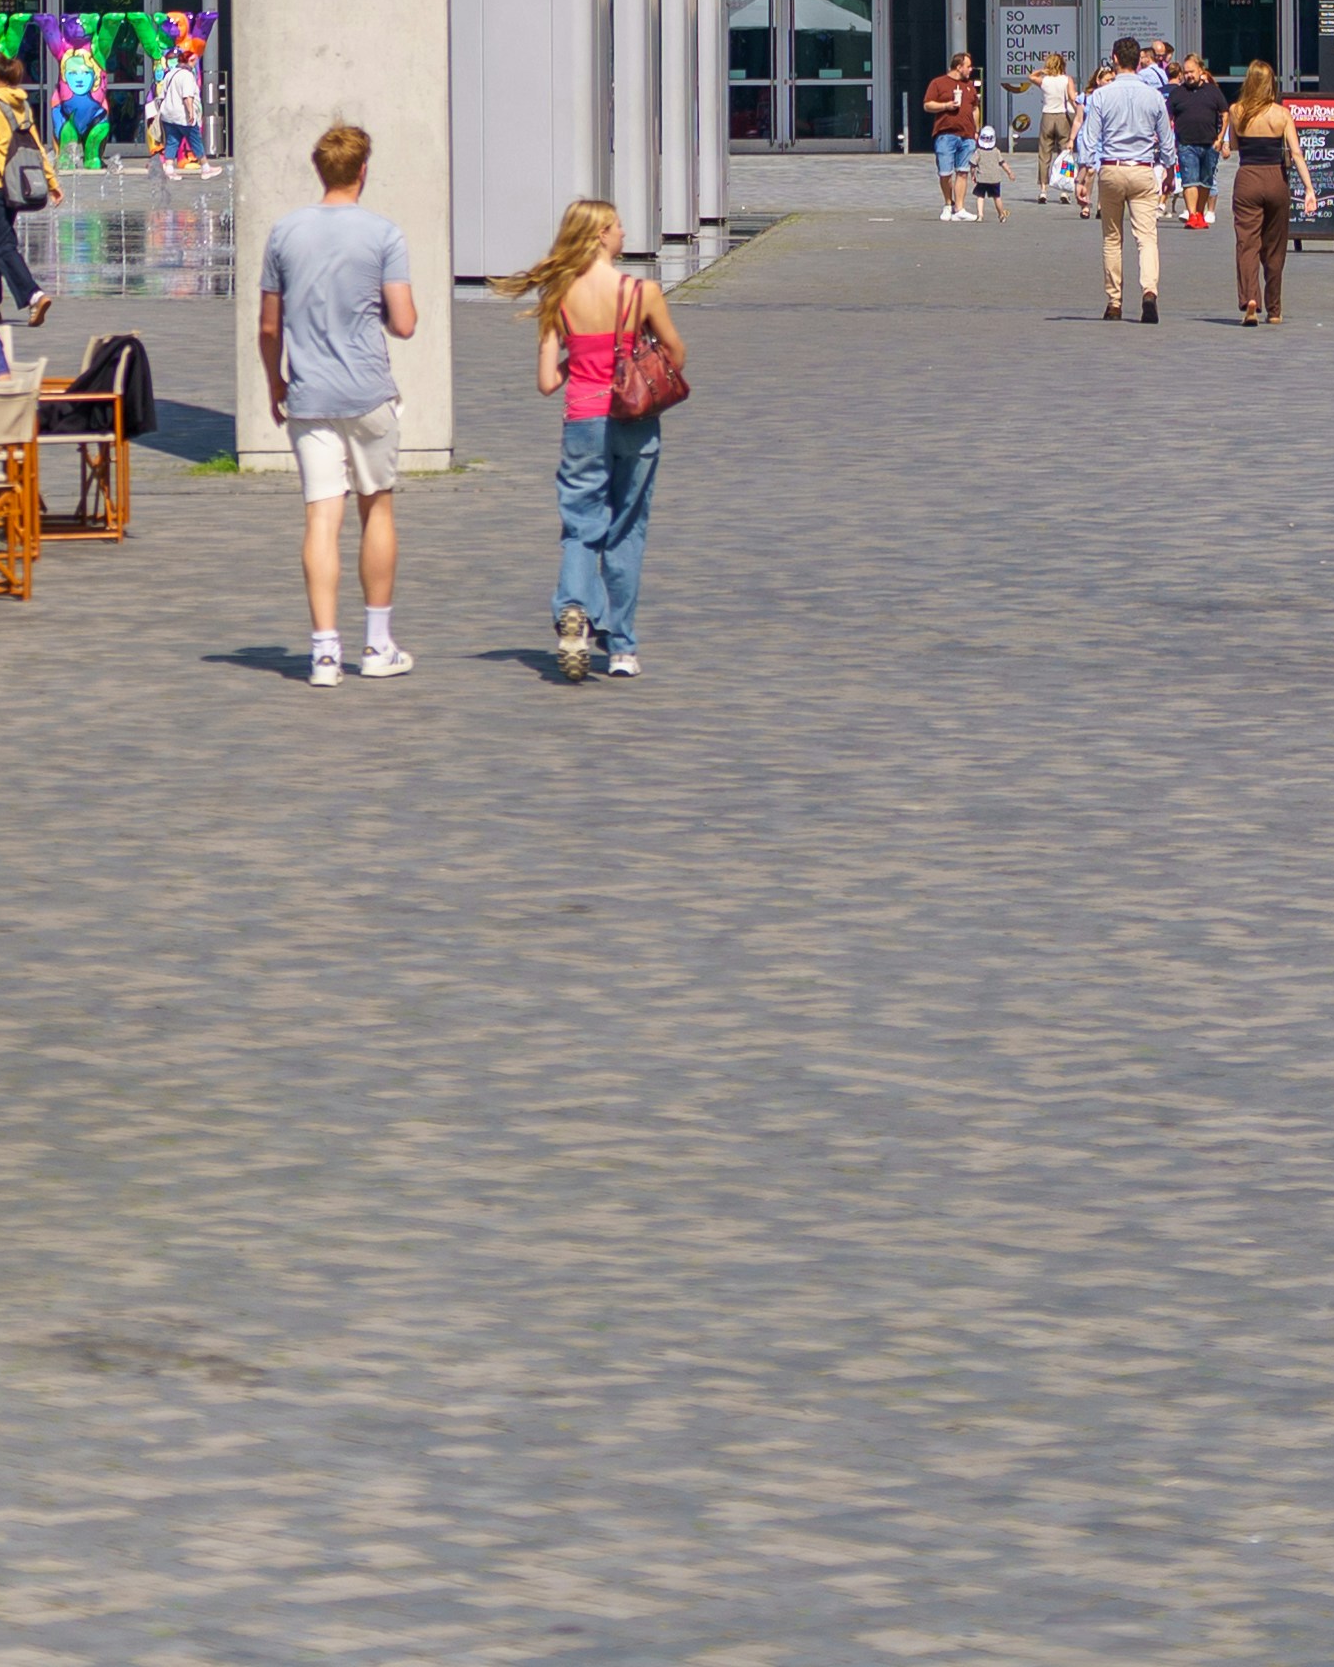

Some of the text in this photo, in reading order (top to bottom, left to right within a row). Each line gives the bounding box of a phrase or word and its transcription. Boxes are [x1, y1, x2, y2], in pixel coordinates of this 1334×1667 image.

[1006, 11, 1024, 22] SO
[1100, 15, 1115, 26] 02
[1006, 24, 1061, 35] KOMMST
[1006, 38, 1024, 48] DU
[1289, 105, 1313, 116] TONY
[1300, 136, 1325, 147] RIBS
[1304, 149, 1334, 161] MOUS
